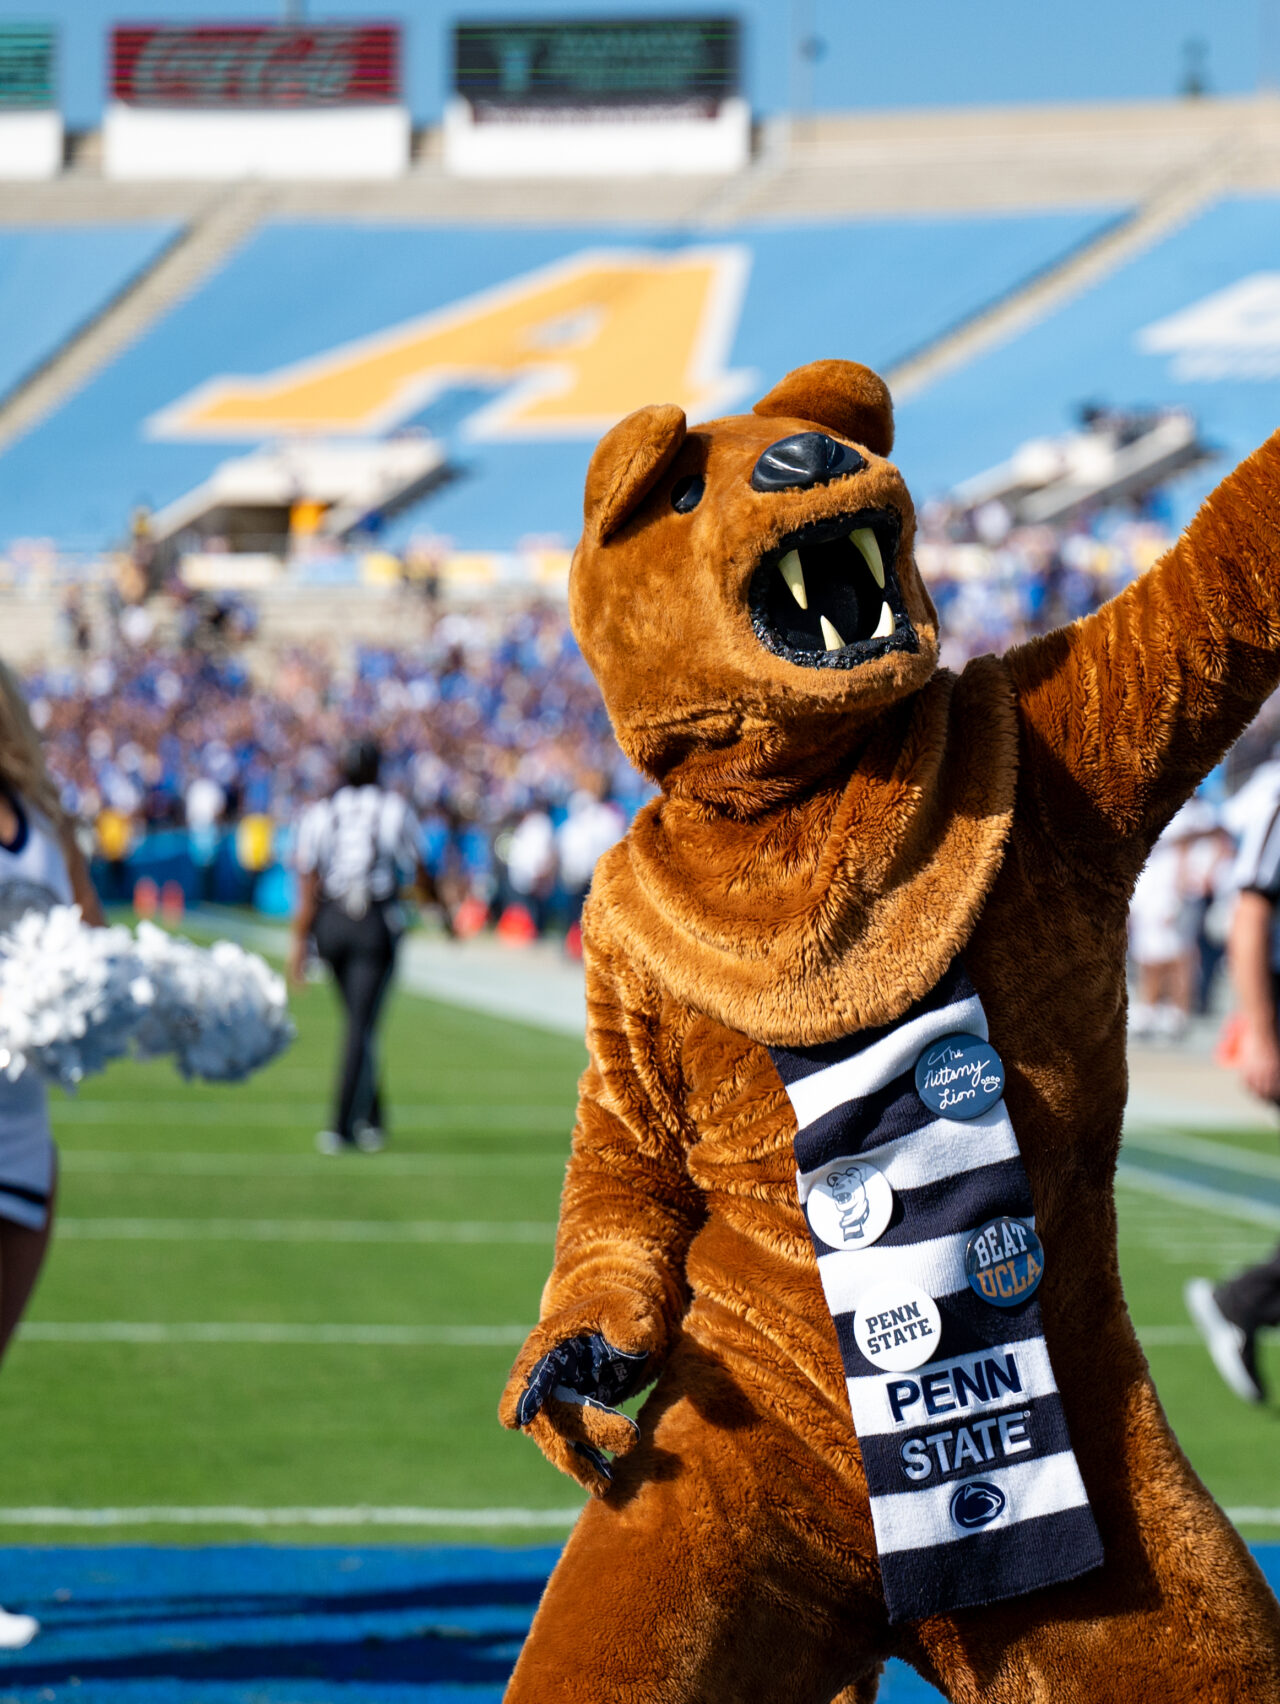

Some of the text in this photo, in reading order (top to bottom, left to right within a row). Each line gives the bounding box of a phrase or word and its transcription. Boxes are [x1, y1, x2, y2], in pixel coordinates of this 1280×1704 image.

[924, 1059, 991, 1089] Nittany
[927, 1046, 964, 1066] The
[938, 1088, 976, 1110] Lion
[974, 1222, 1028, 1268] BEAT
[976, 1252, 1042, 1298] UCLA
[865, 1301, 921, 1335] PENN
[866, 1318, 933, 1355] STATE
[886, 1353, 1022, 1423] PENN
[902, 1411, 1032, 1481] STATE
